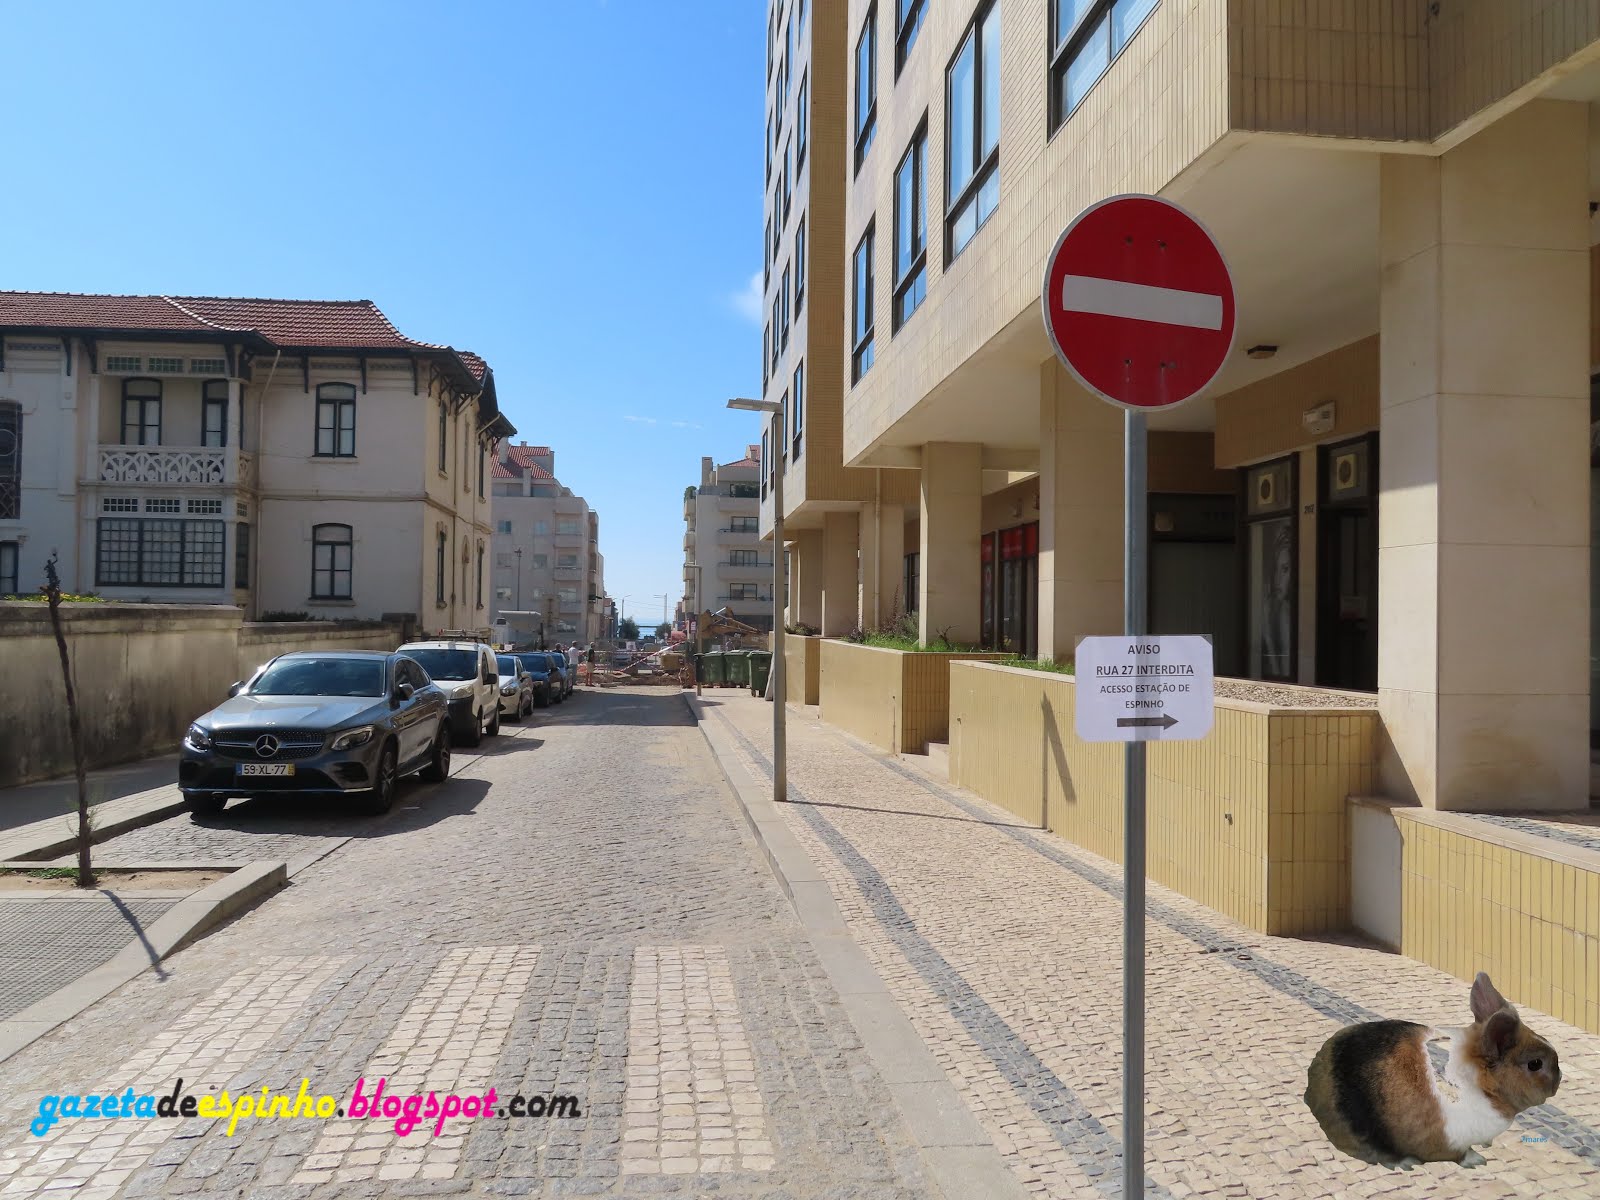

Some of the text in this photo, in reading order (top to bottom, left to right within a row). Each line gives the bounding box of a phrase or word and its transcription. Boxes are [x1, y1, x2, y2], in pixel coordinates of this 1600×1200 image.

[1128, 645, 1160, 654] AVISO
[1096, 664, 1194, 675] RUA 27 INTERDITA
[1100, 683, 1190, 695] ACESSO ESTAÇÃO DE
[1125, 700, 1164, 709] ESPINHO
